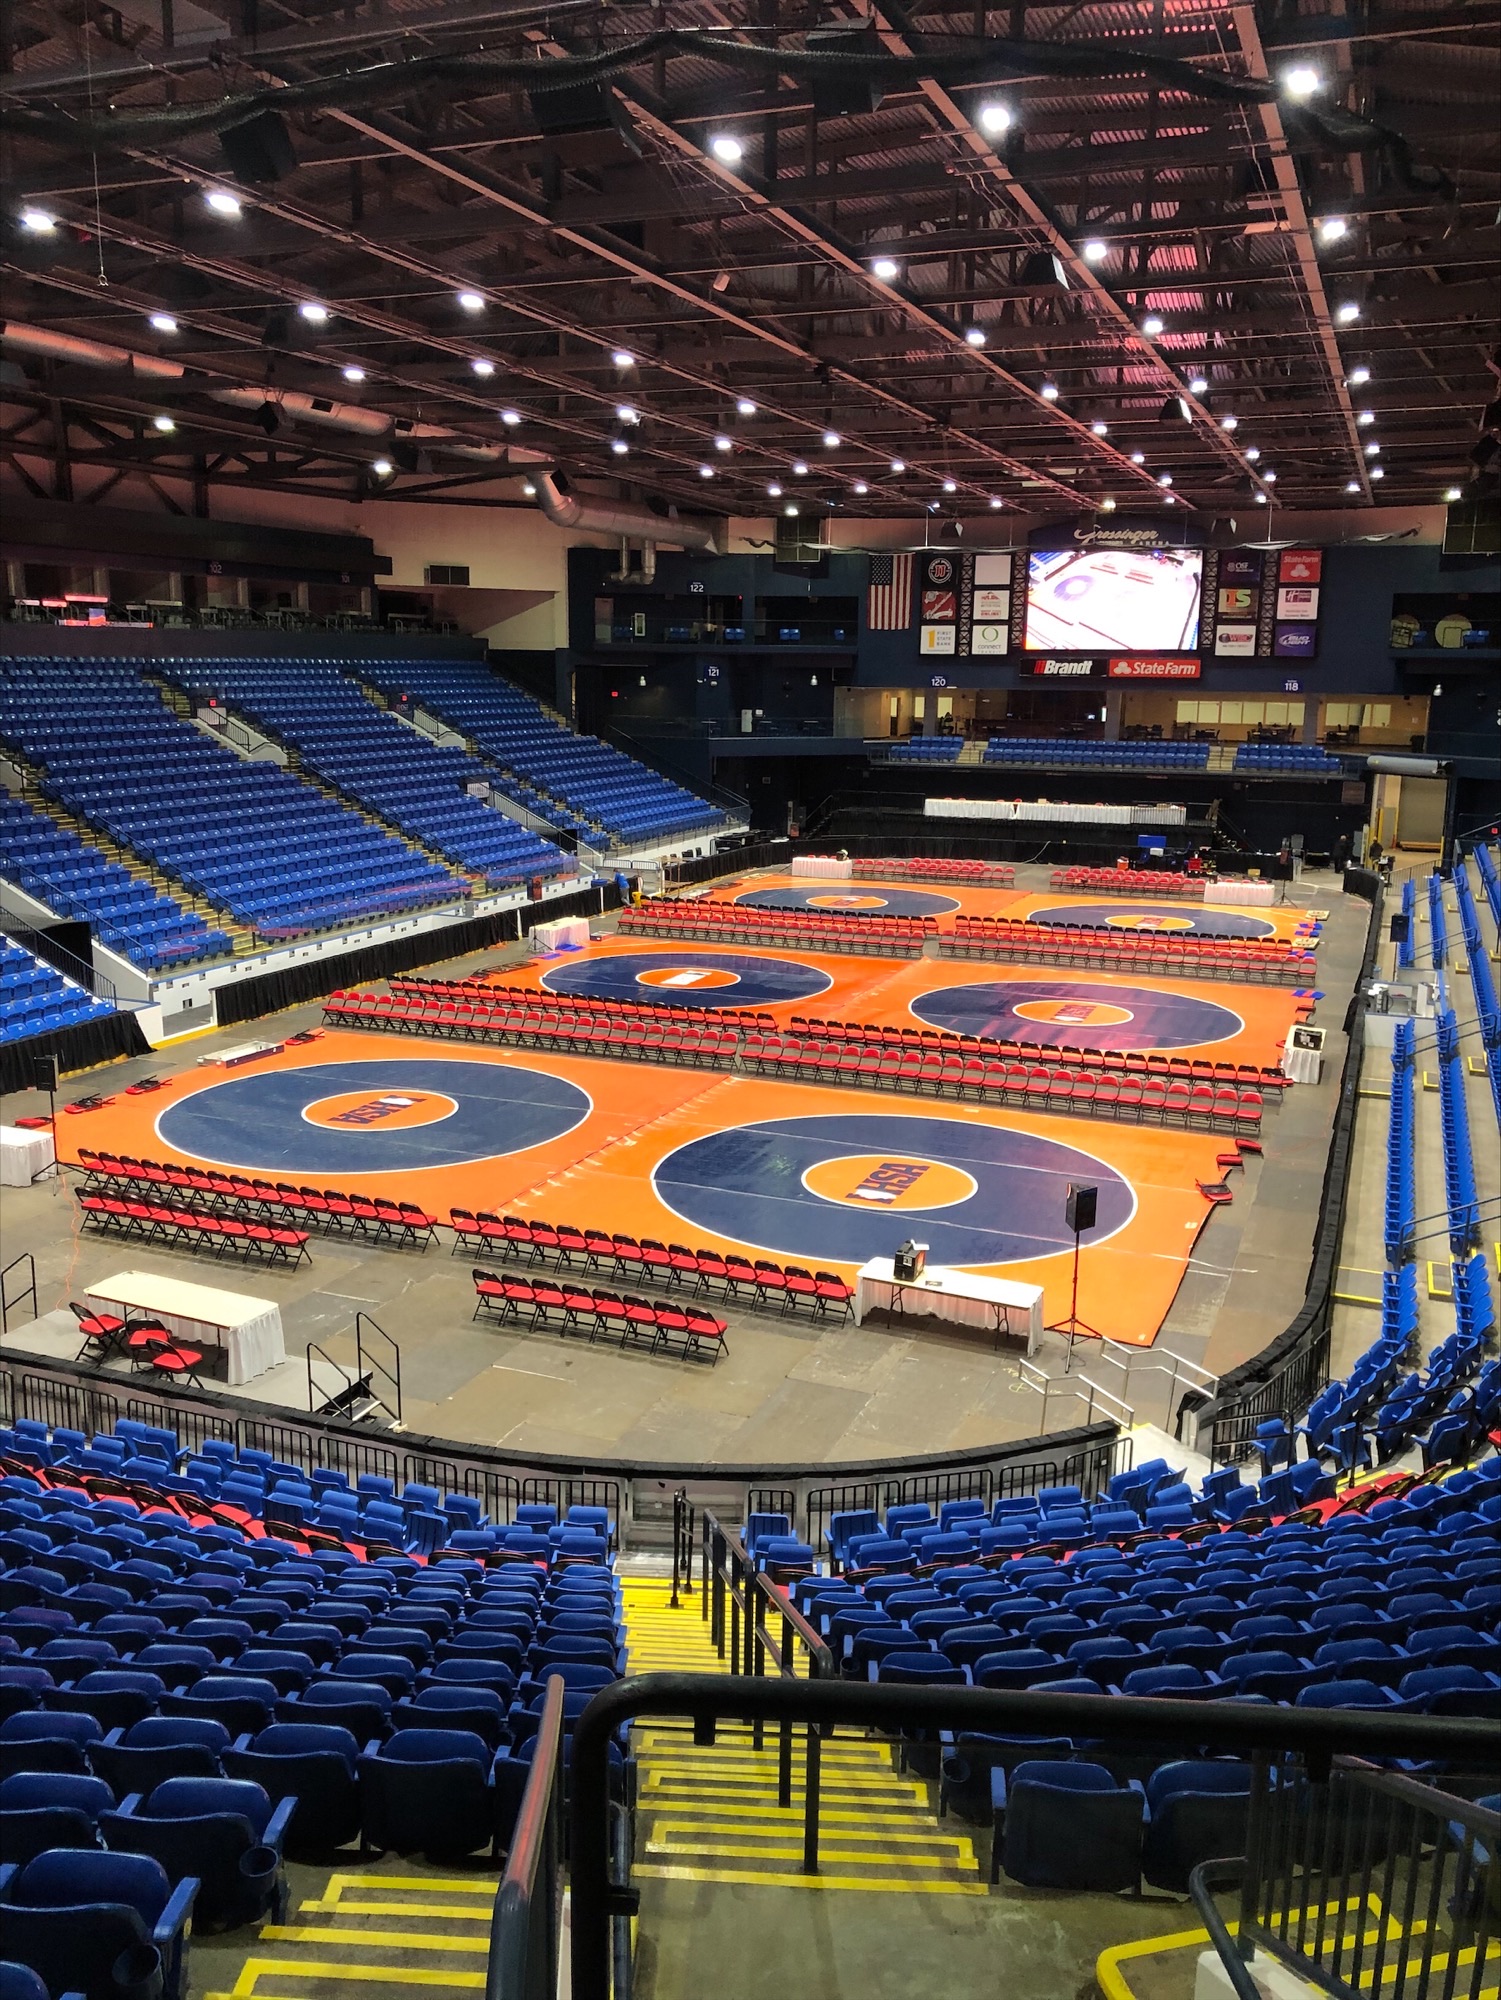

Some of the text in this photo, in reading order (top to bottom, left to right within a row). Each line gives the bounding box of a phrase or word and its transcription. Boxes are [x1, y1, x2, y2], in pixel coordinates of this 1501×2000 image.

[1073, 524, 1159, 545] Grossinger
[690, 584, 704, 592] 122
[1044, 660, 1093, 674] Brandt
[931, 678, 946, 686] 120
[1285, 683, 1298, 691] 118
